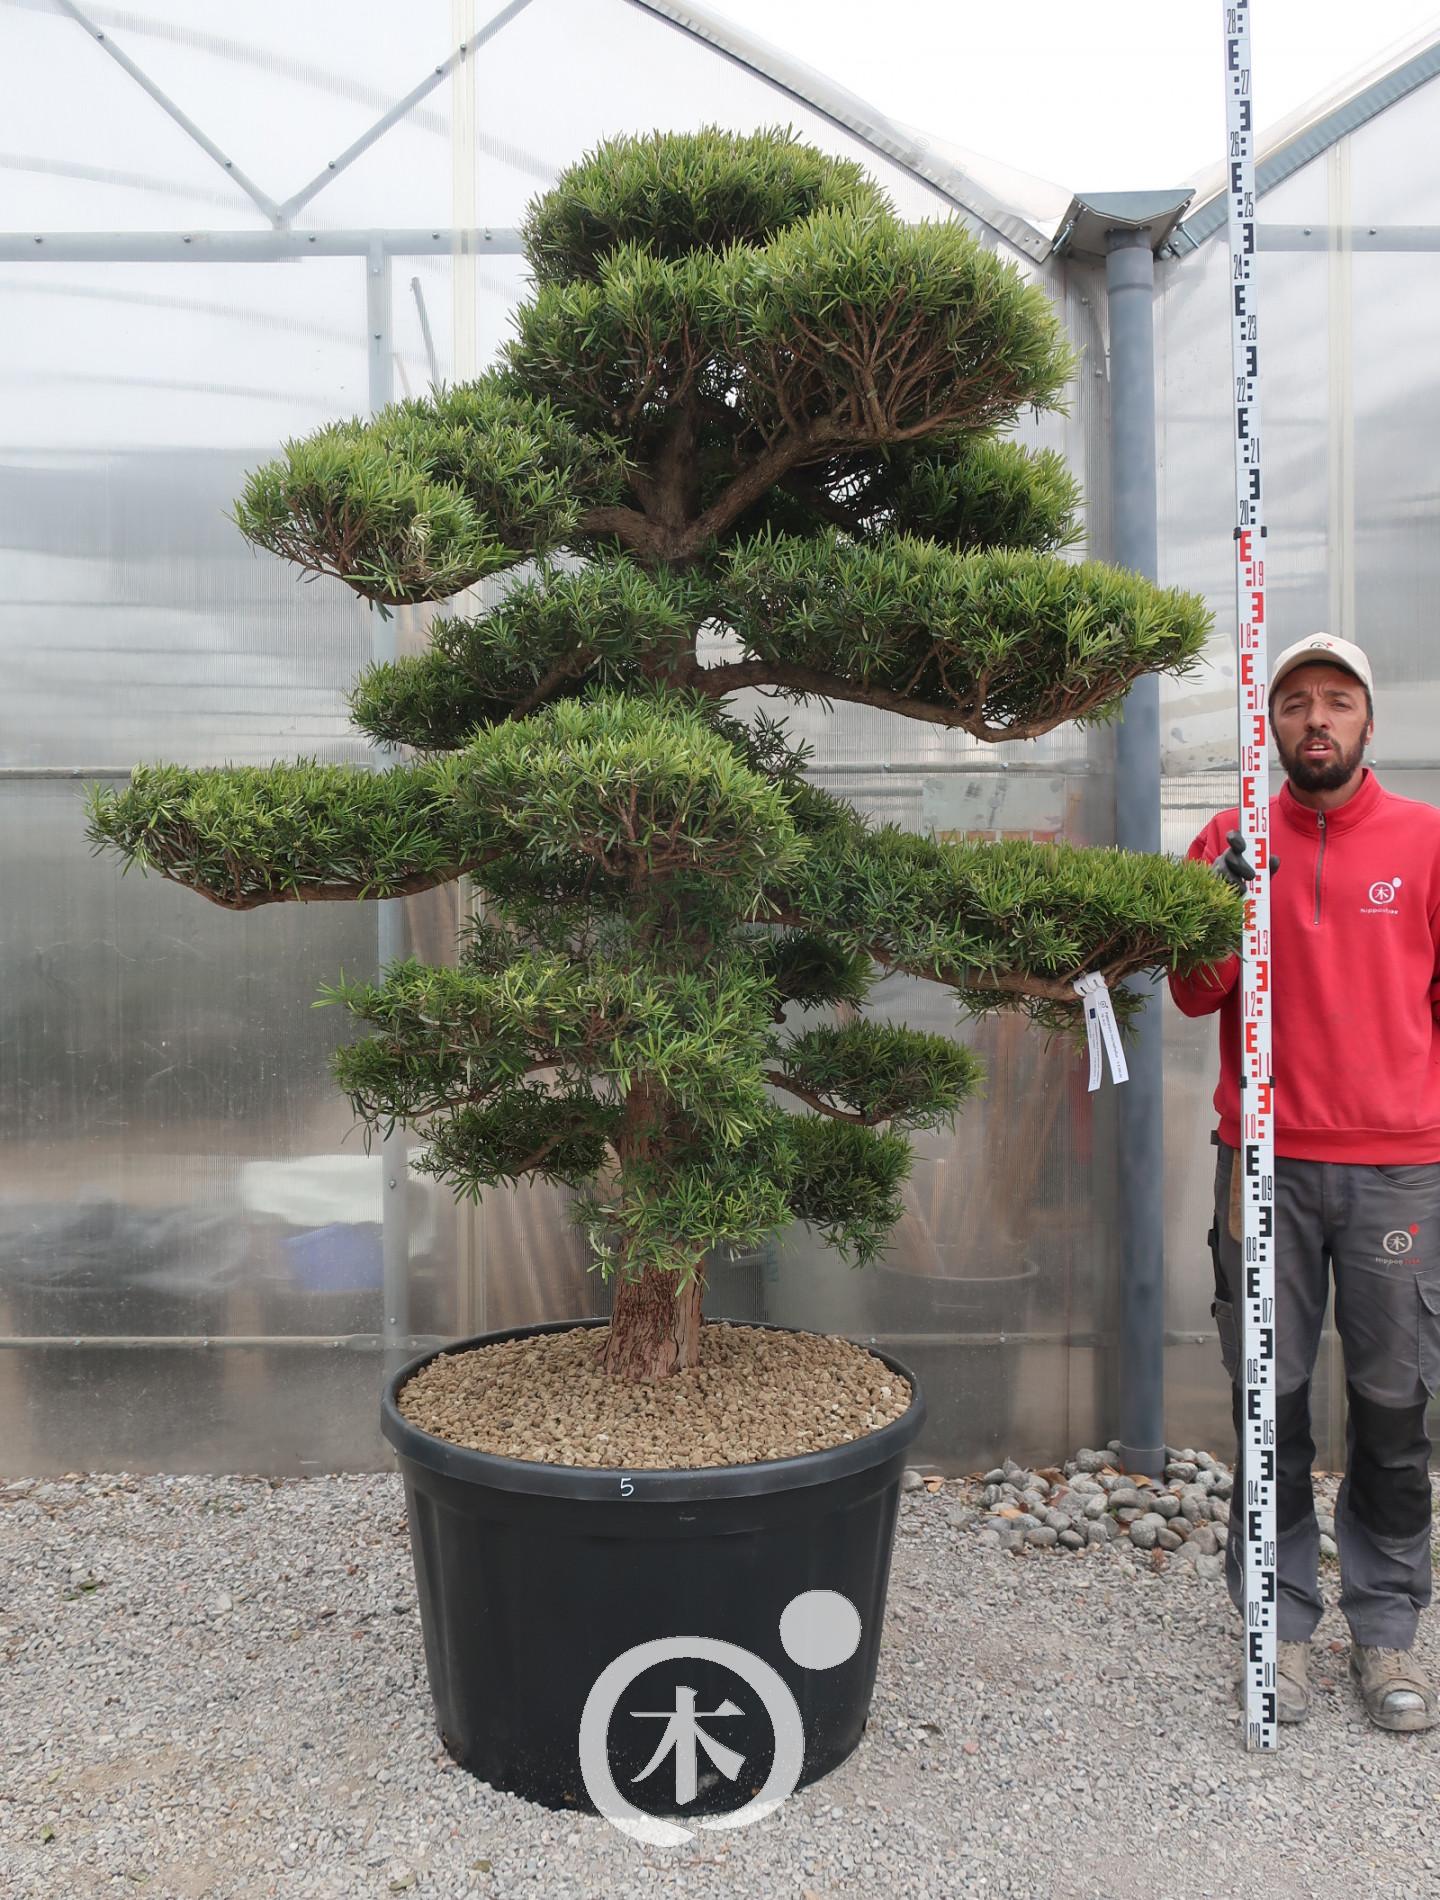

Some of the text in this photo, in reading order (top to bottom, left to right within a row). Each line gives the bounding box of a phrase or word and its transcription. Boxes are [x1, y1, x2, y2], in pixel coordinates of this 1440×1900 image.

[1227, 9, 1236, 34] 28
[1241, 70, 1250, 95] 27
[1231, 131, 1240, 156] 26
[1244, 192, 1254, 217] 25
[1234, 254, 1243, 279] 24
[1248, 315, 1257, 340] 23
[1237, 377, 1246, 402] 22
[1251, 438, 1260, 463] 21
[1240, 500, 1249, 525] 20
[1253, 561, 1264, 586] 19
[1241, 623, 1251, 648] 18
[1255, 684, 1265, 709] 17
[1242, 746, 1253, 771] 16
[1256, 807, 1267, 832] 15
[1258, 930, 1268, 955] 13
[1245, 991, 1256, 1017] 12
[1259, 1052, 1270, 1077] 11
[1245, 1114, 1256, 1139] 10
[1262, 1175, 1272, 1201] 09
[1246, 1237, 1257, 1262] 08
[1263, 1298, 1273, 1323] 07
[1247, 1359, 1258, 1384] 06
[1264, 1420, 1274, 1445] 05
[620, 1477, 635, 1497] 5
[1248, 1480, 1259, 1505] 04
[1264, 1541, 1275, 1566] 03
[1249, 1602, 1260, 1627] 02
[1265, 1662, 1276, 1687] 01
